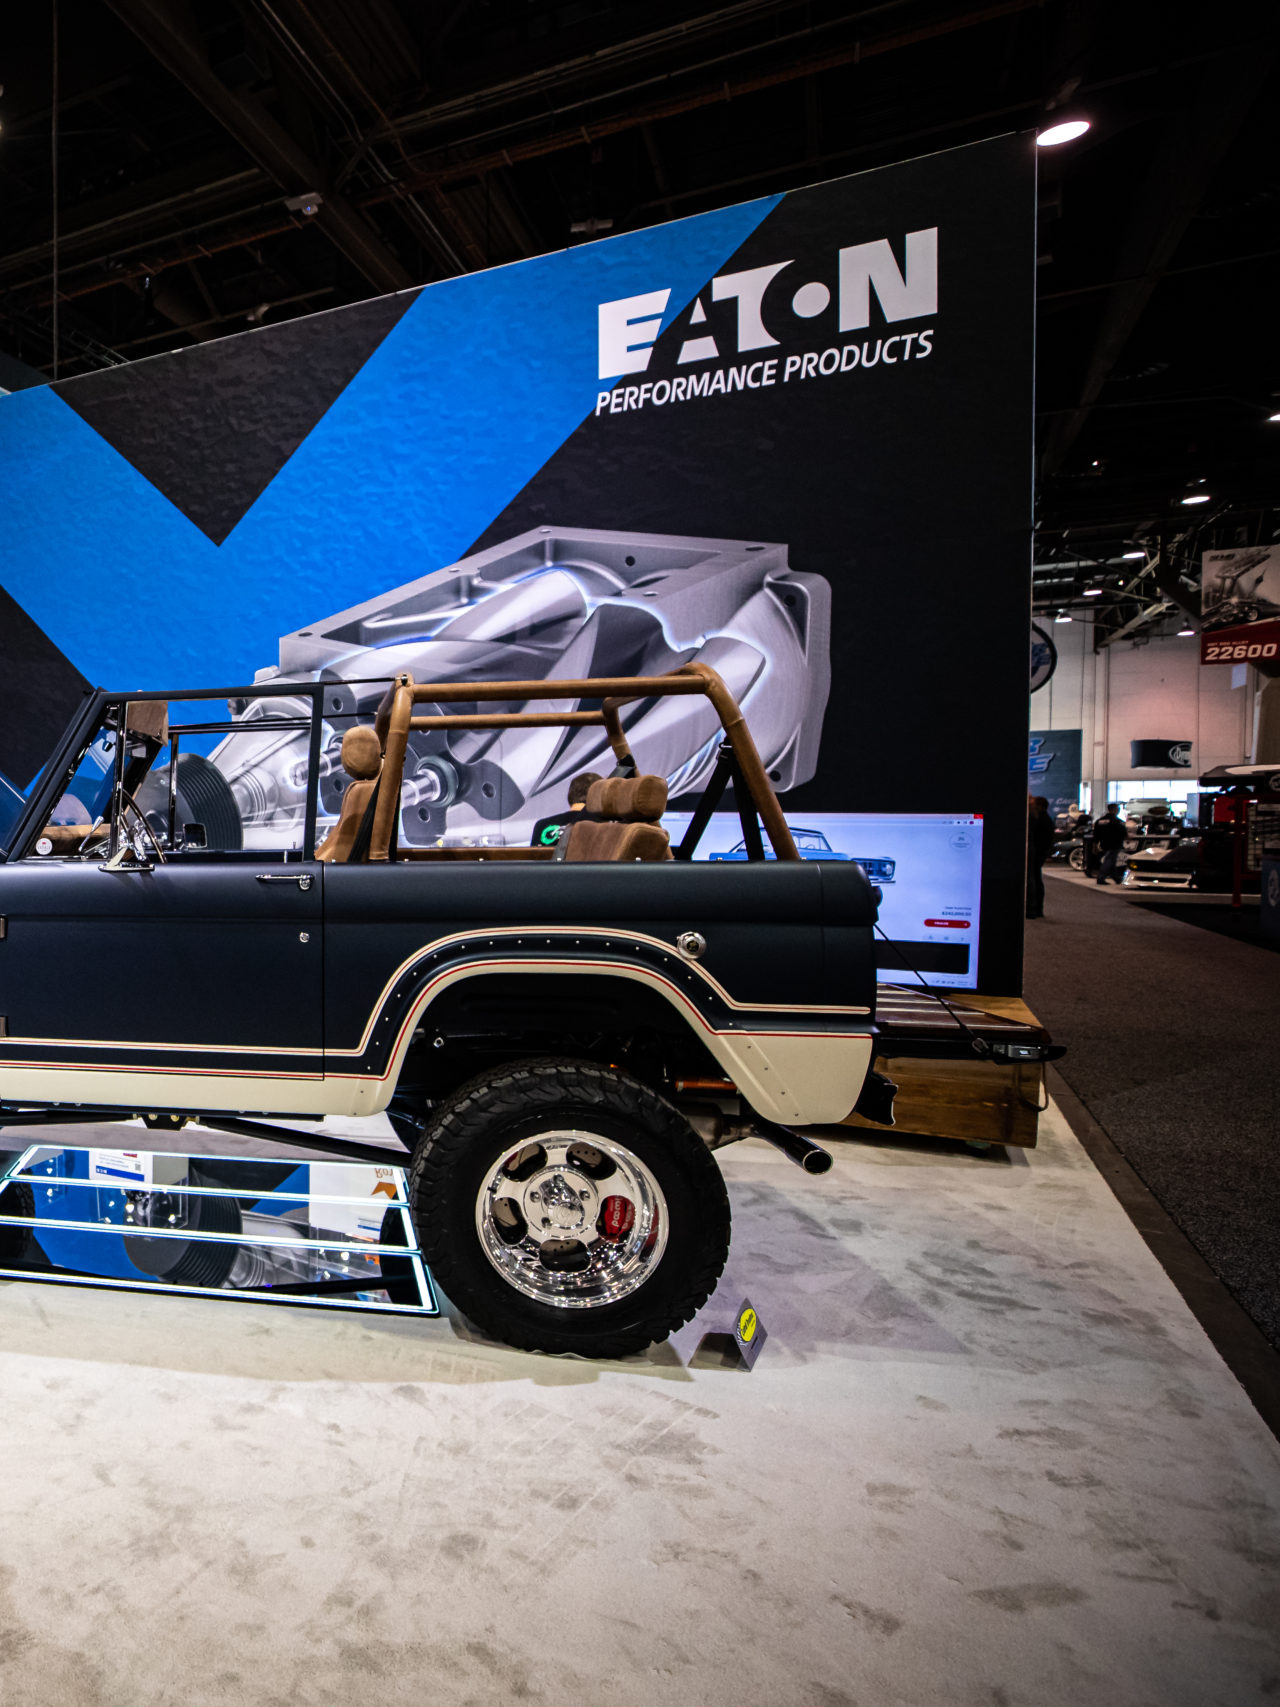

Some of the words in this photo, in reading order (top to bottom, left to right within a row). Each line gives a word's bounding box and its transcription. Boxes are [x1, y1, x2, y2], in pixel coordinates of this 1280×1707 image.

[598, 227, 938, 380] EATON
[595, 359, 778, 416] PERFORMANCE
[783, 329, 934, 382] PRODUCTS
[1205, 643, 1277, 660] 22600
